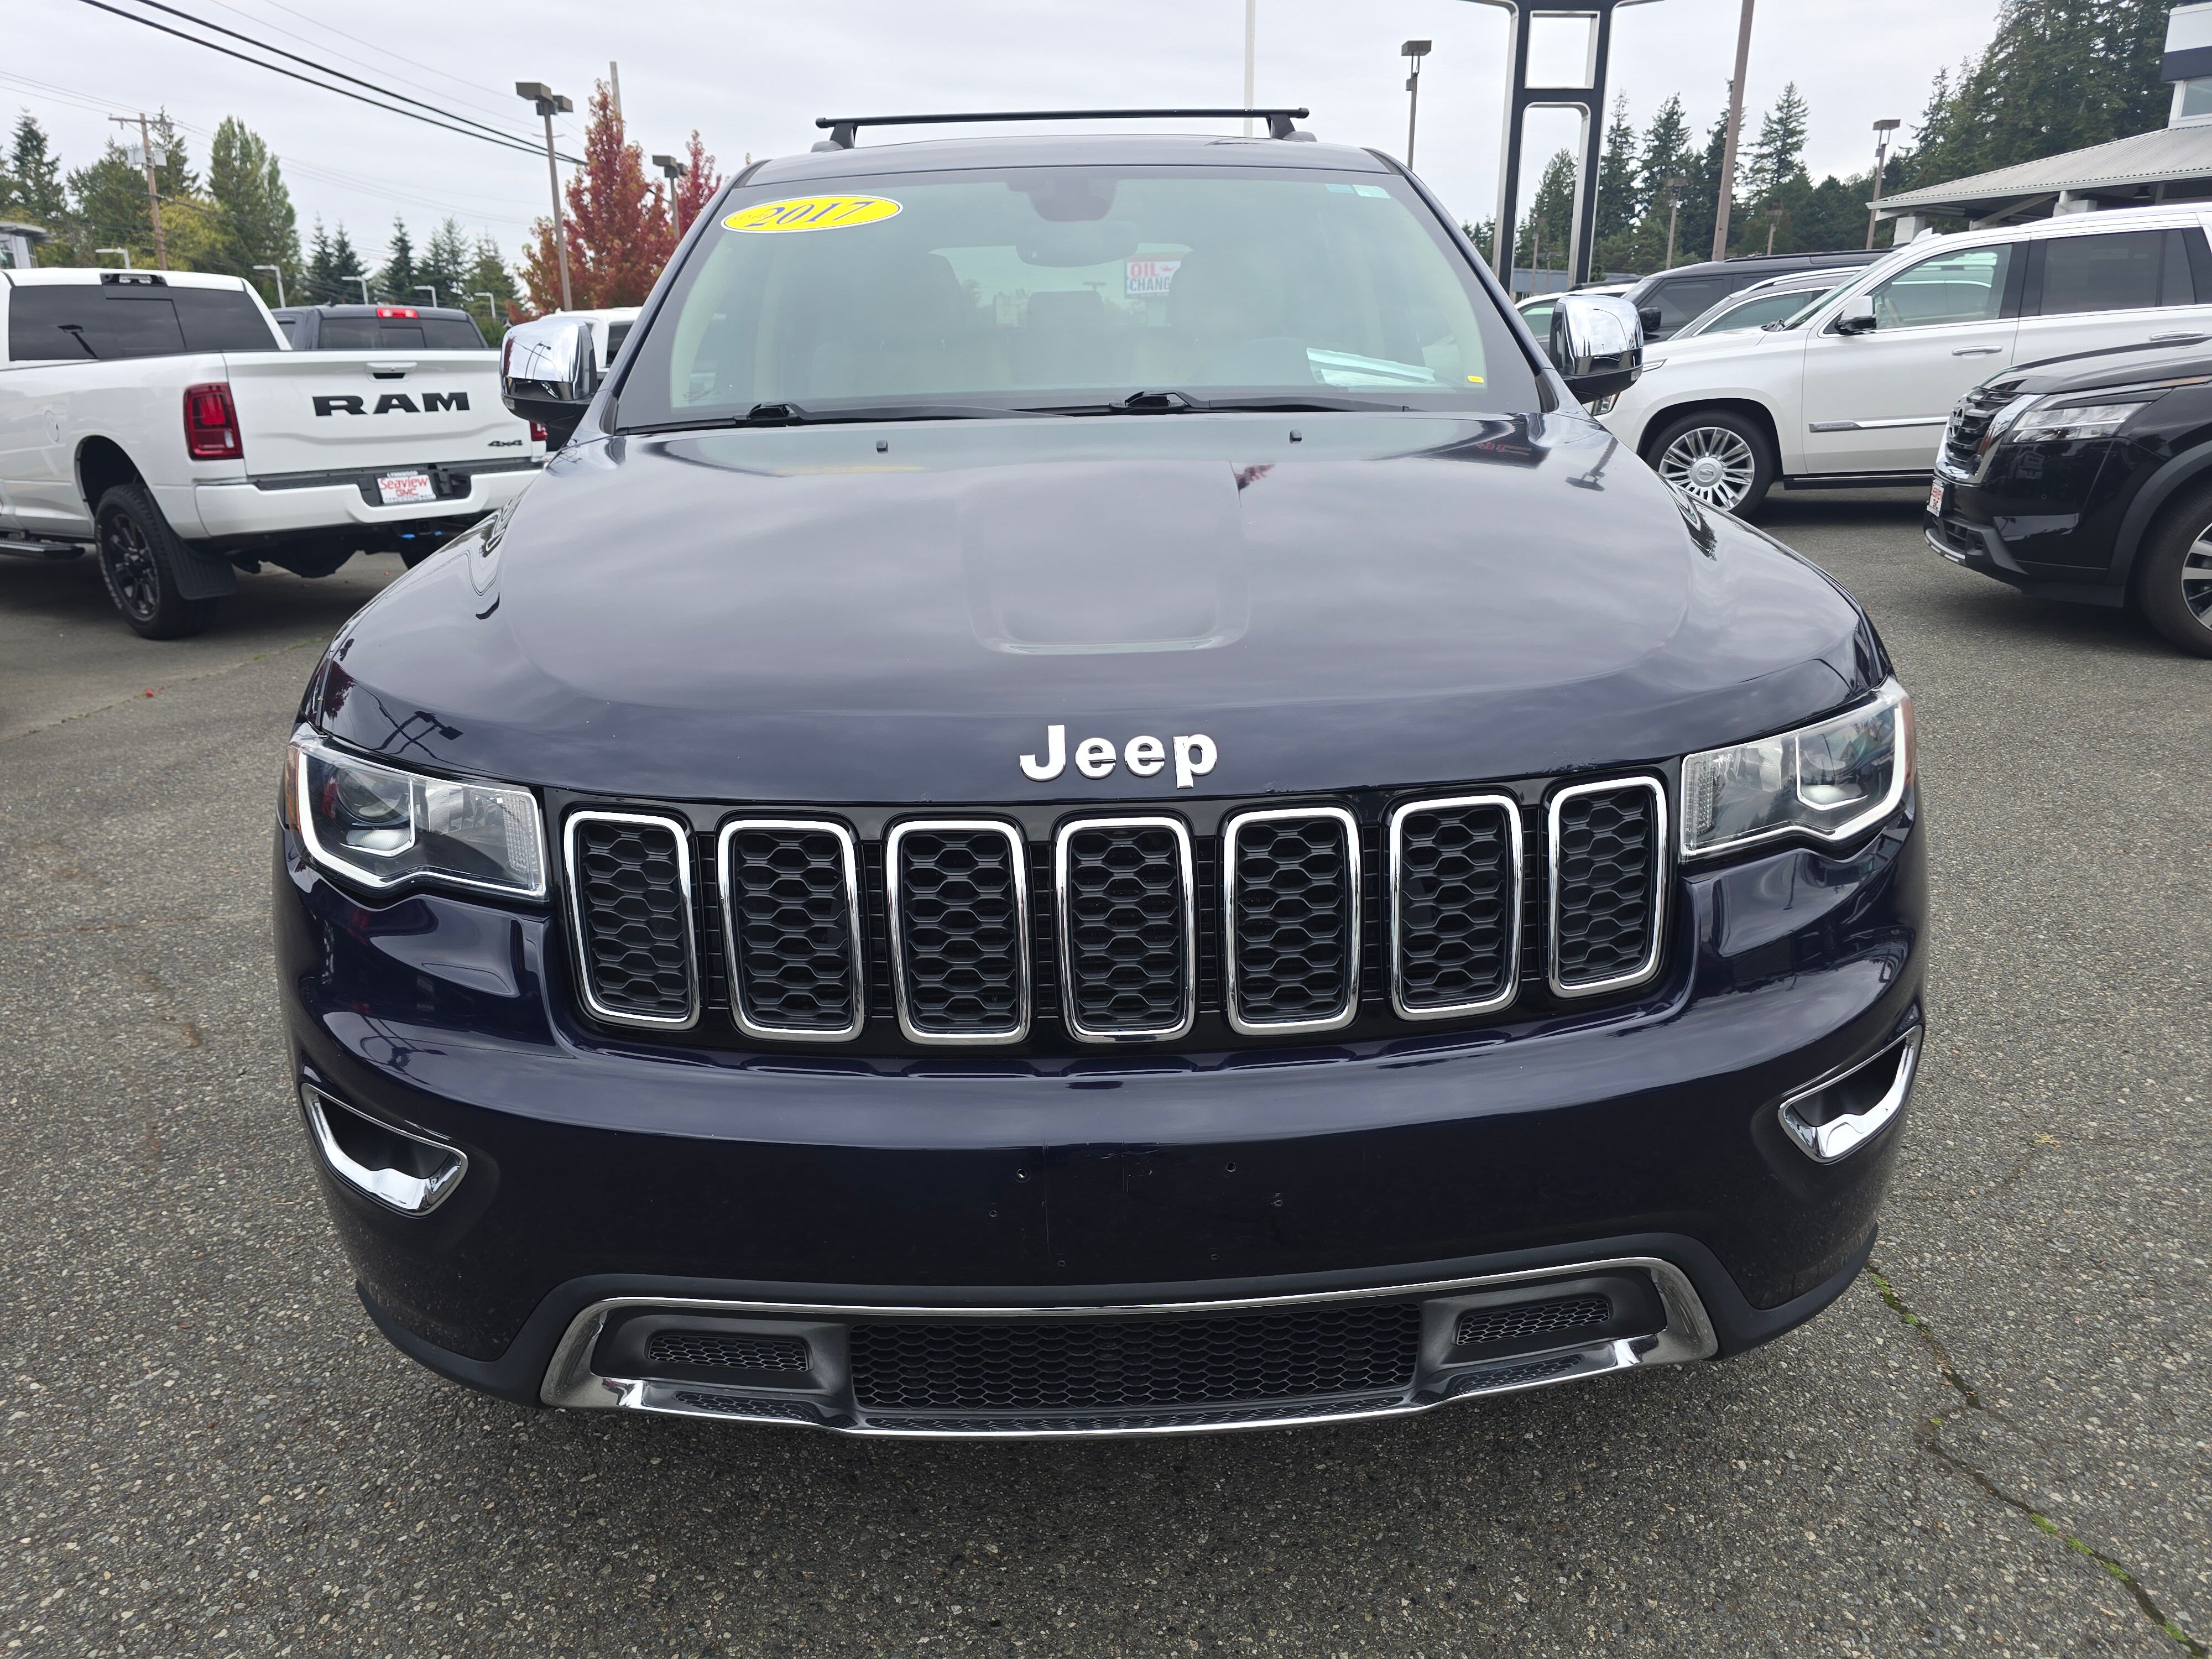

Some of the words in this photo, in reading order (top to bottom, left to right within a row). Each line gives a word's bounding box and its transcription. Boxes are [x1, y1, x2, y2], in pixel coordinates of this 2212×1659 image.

[743, 201, 877, 227] 2017
[1130, 262, 1160, 278] OIL
[1130, 277, 1171, 291] CHANG
[312, 392, 470, 416] RAM
[380, 476, 428, 489] Seaview
[395, 488, 419, 497] GMC
[1019, 724, 1218, 789] Jeep
